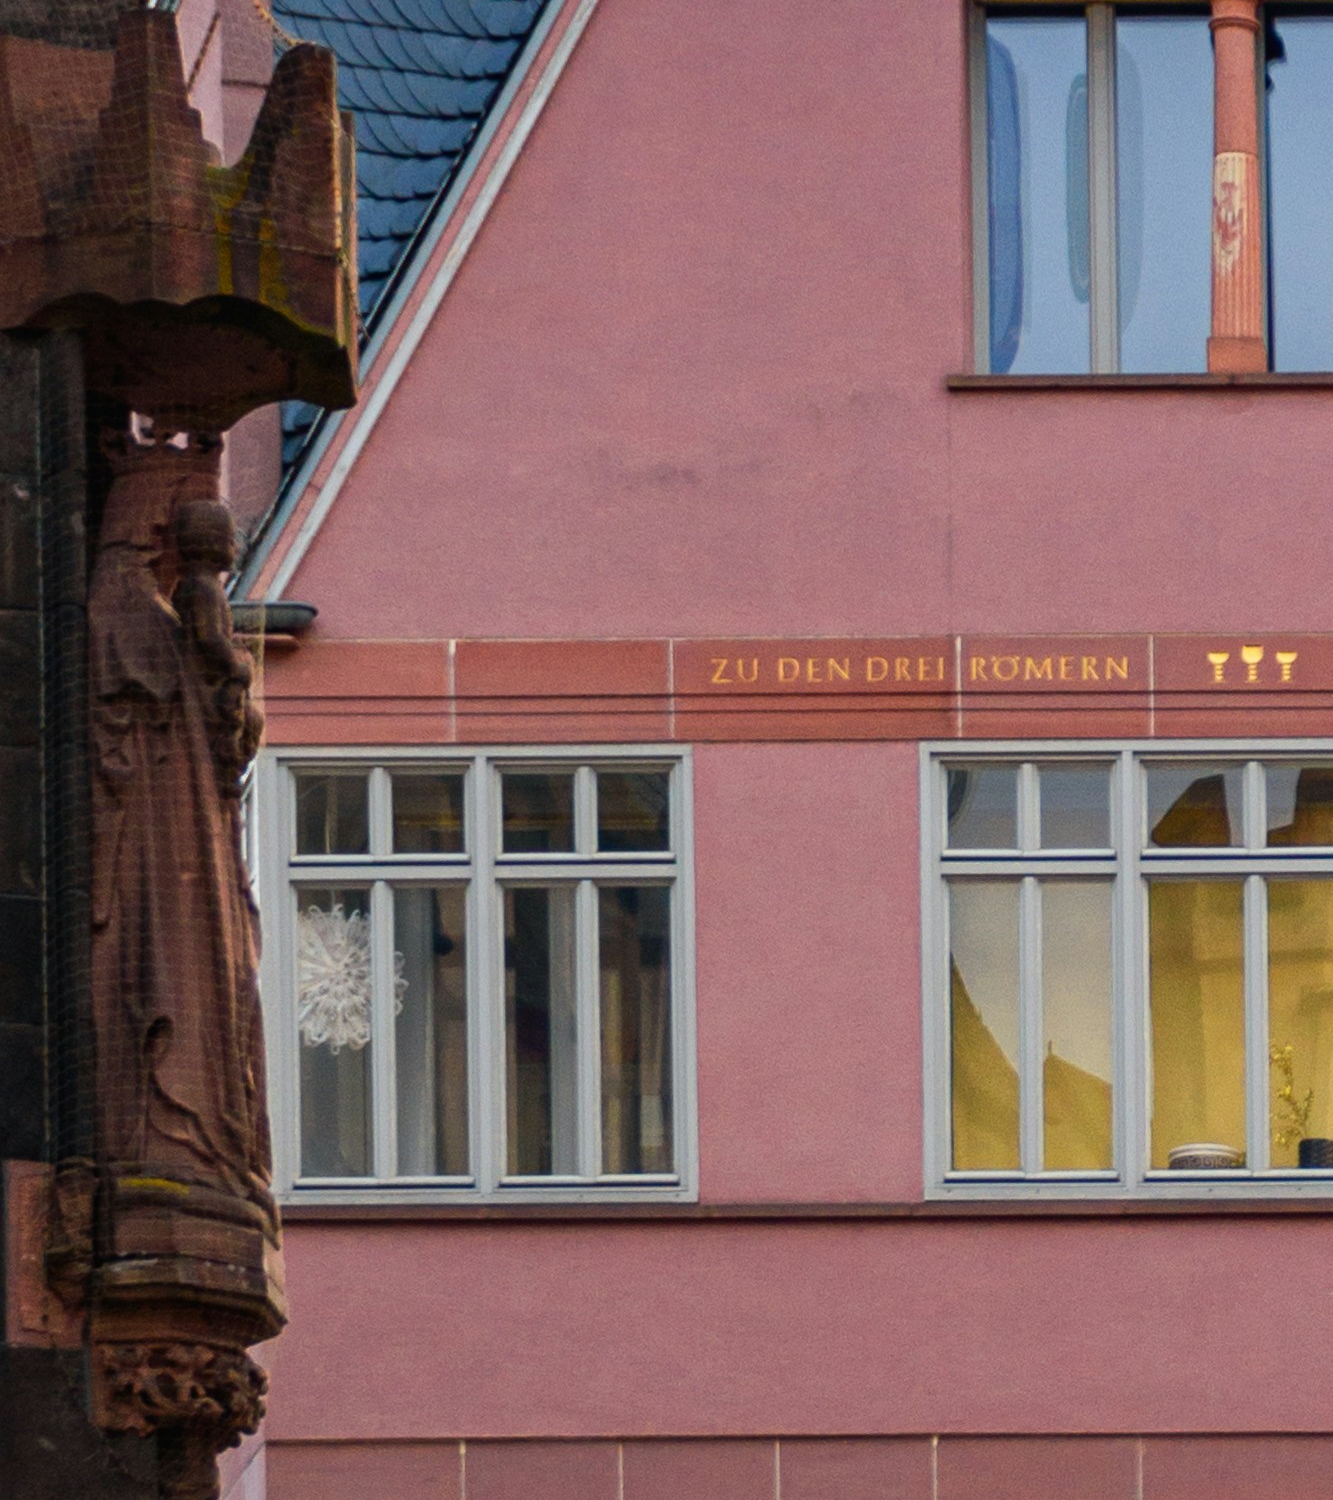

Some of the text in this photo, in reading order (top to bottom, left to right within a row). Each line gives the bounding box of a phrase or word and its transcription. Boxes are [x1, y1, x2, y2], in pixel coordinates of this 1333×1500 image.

[710, 654, 1131, 685] ZU DEN DREI RÖMERN
